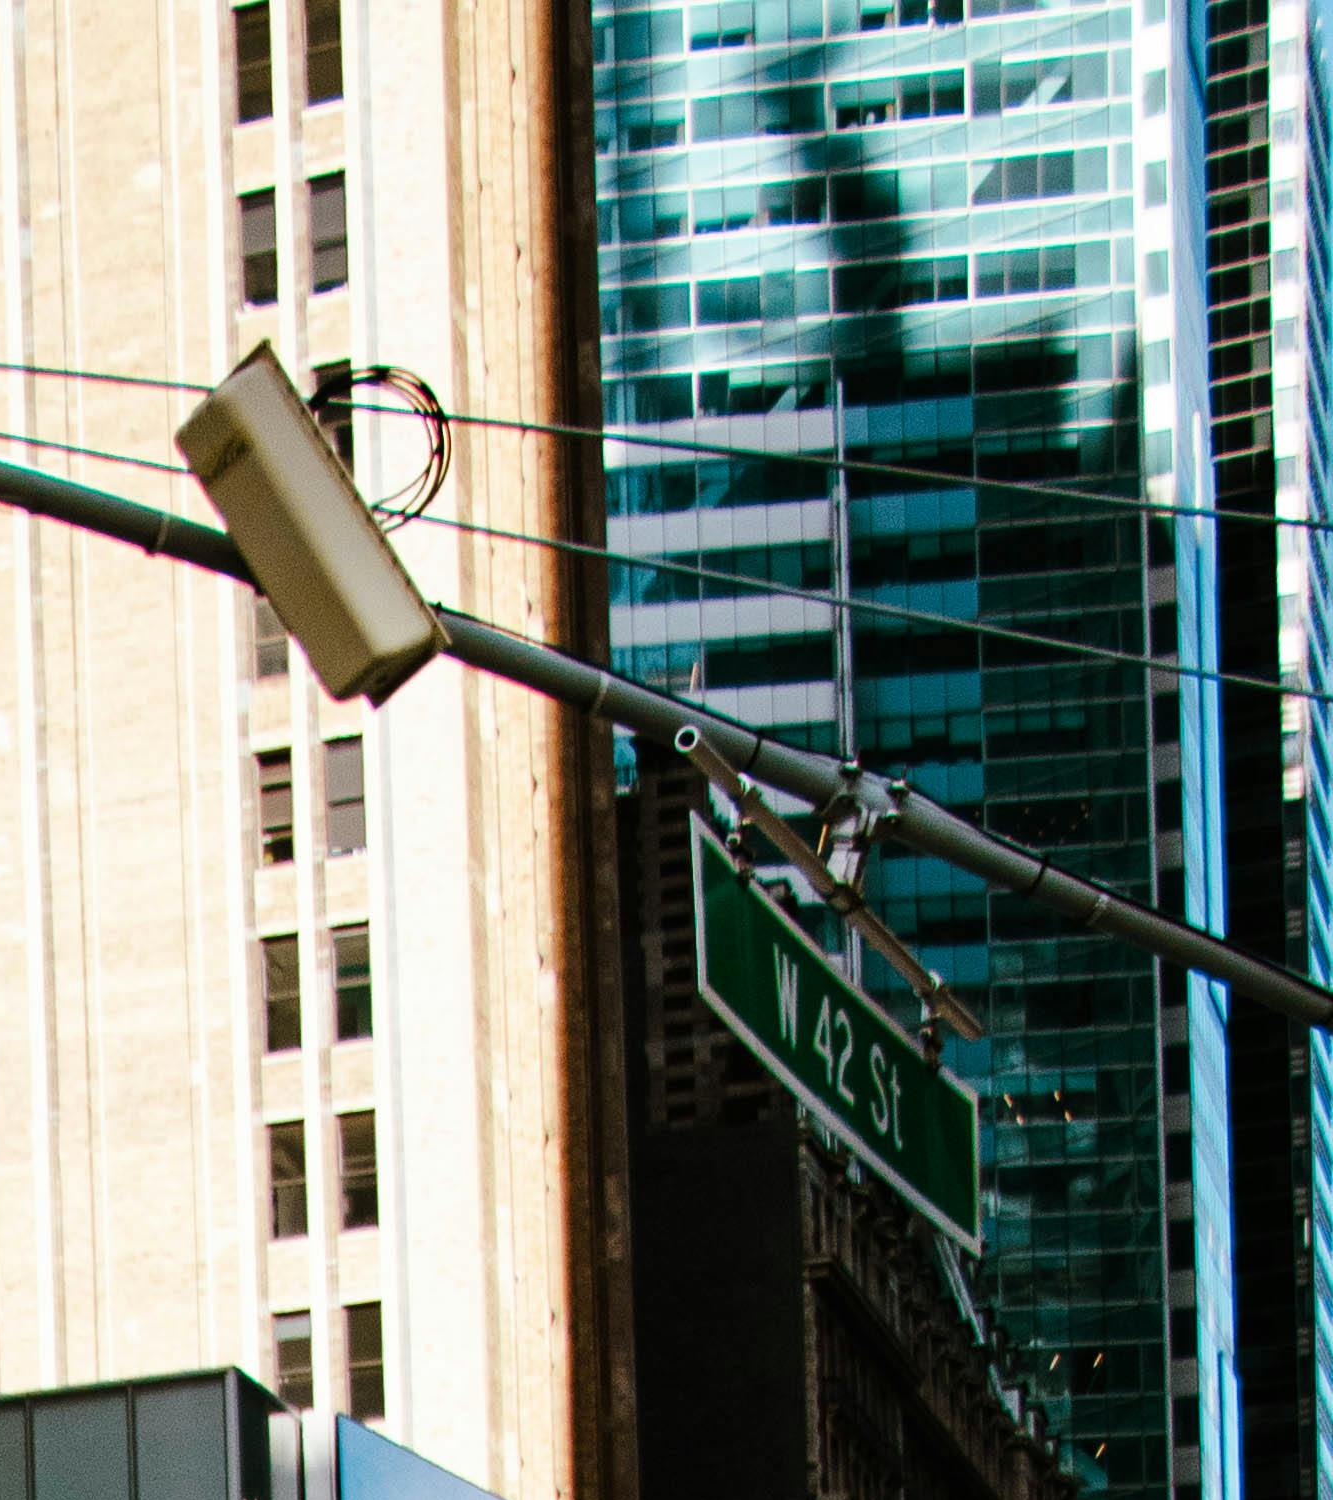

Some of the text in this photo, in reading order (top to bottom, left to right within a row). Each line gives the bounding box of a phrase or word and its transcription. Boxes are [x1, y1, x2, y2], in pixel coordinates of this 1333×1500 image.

[772, 943, 905, 1152] W 42 St
